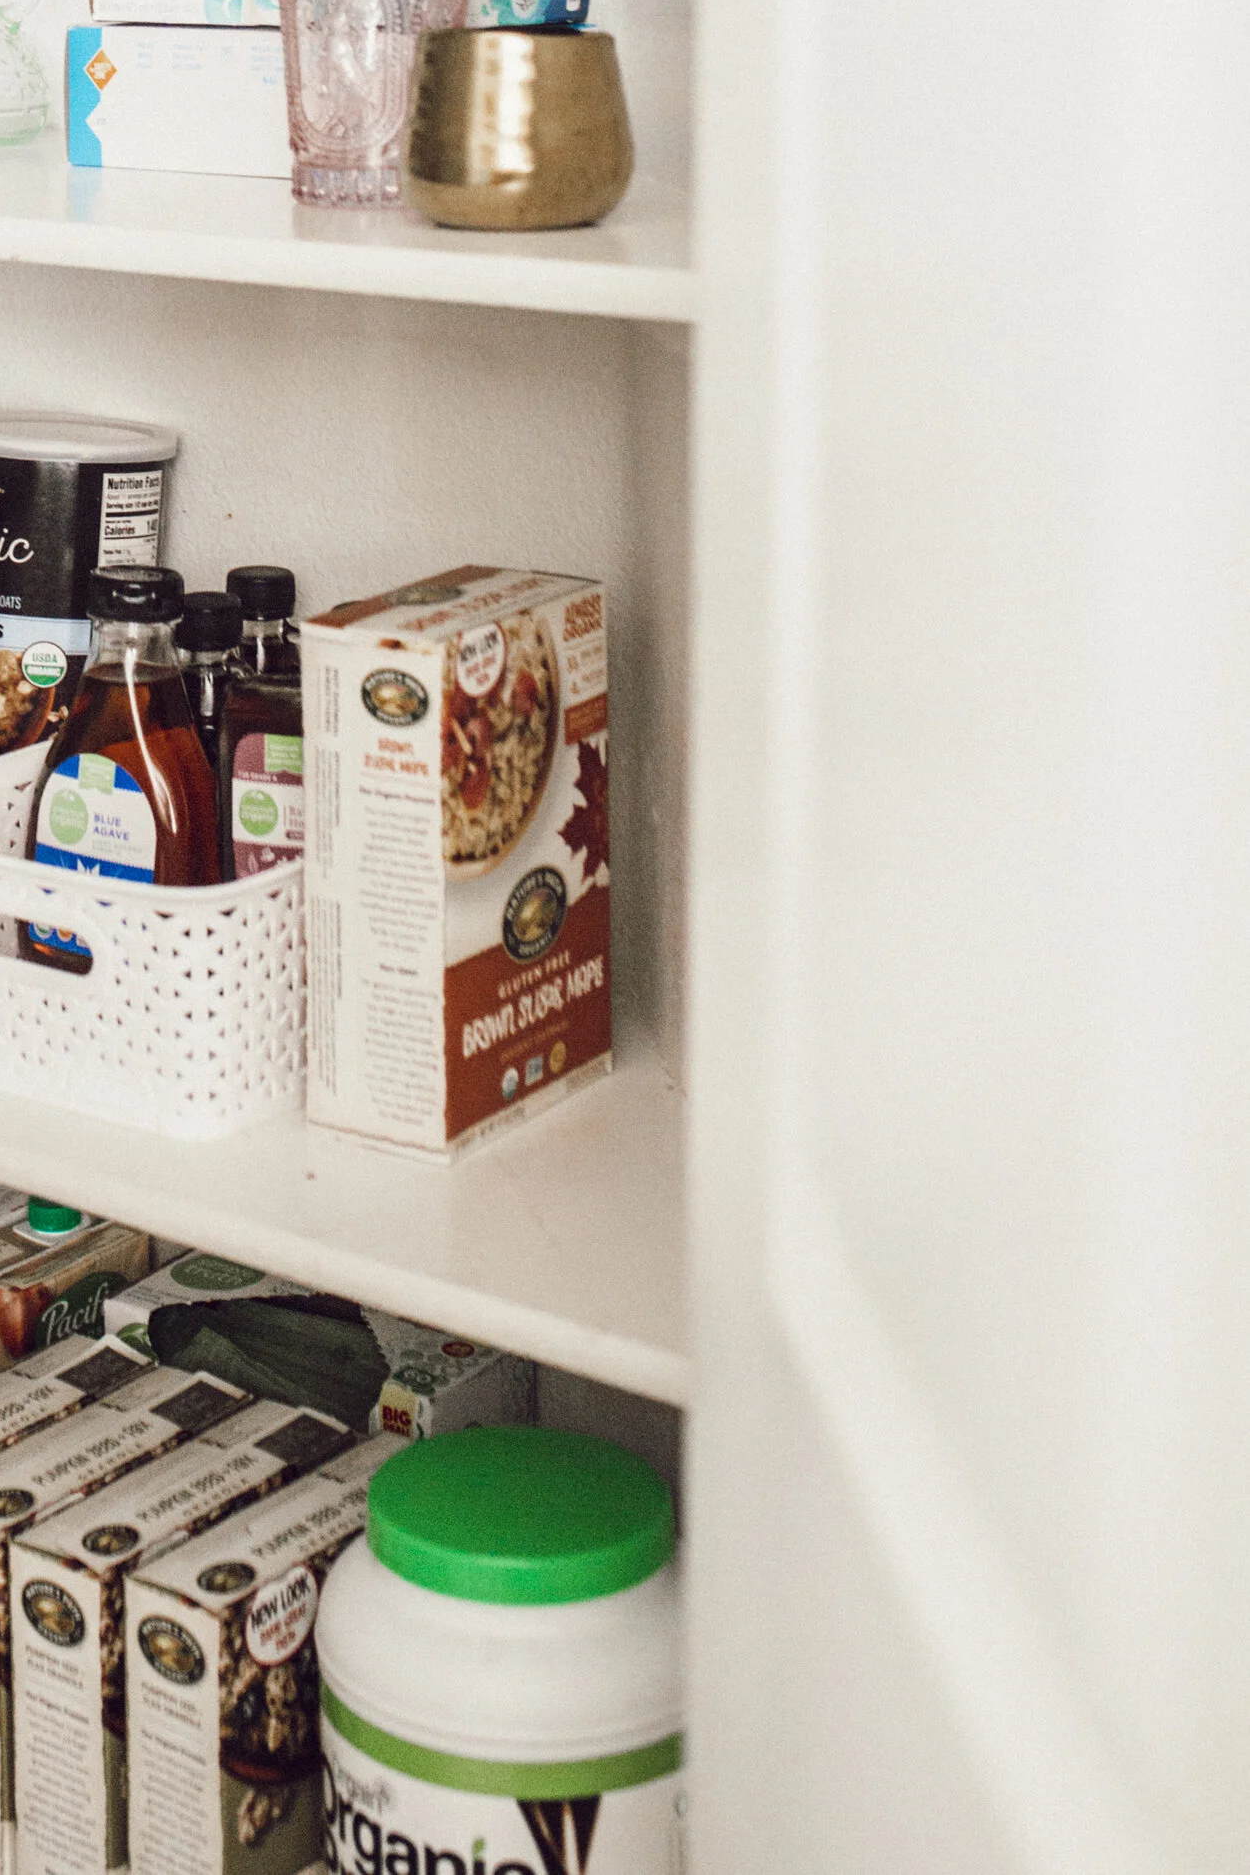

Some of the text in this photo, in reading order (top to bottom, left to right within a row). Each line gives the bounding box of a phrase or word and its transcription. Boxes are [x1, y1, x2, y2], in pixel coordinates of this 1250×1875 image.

[107, 476, 144, 491] Nutrition
[104, 524, 137, 537] Calories
[0, 595, 23, 611] OATS
[31, 651, 59, 665] USDA
[93, 813, 122, 827] BLUE
[93, 825, 130, 842] AGAVE
[41, 1281, 109, 1346] Pacif
[382, 1404, 413, 1427] BIG
[250, 1572, 312, 1630] NEW LOOK
